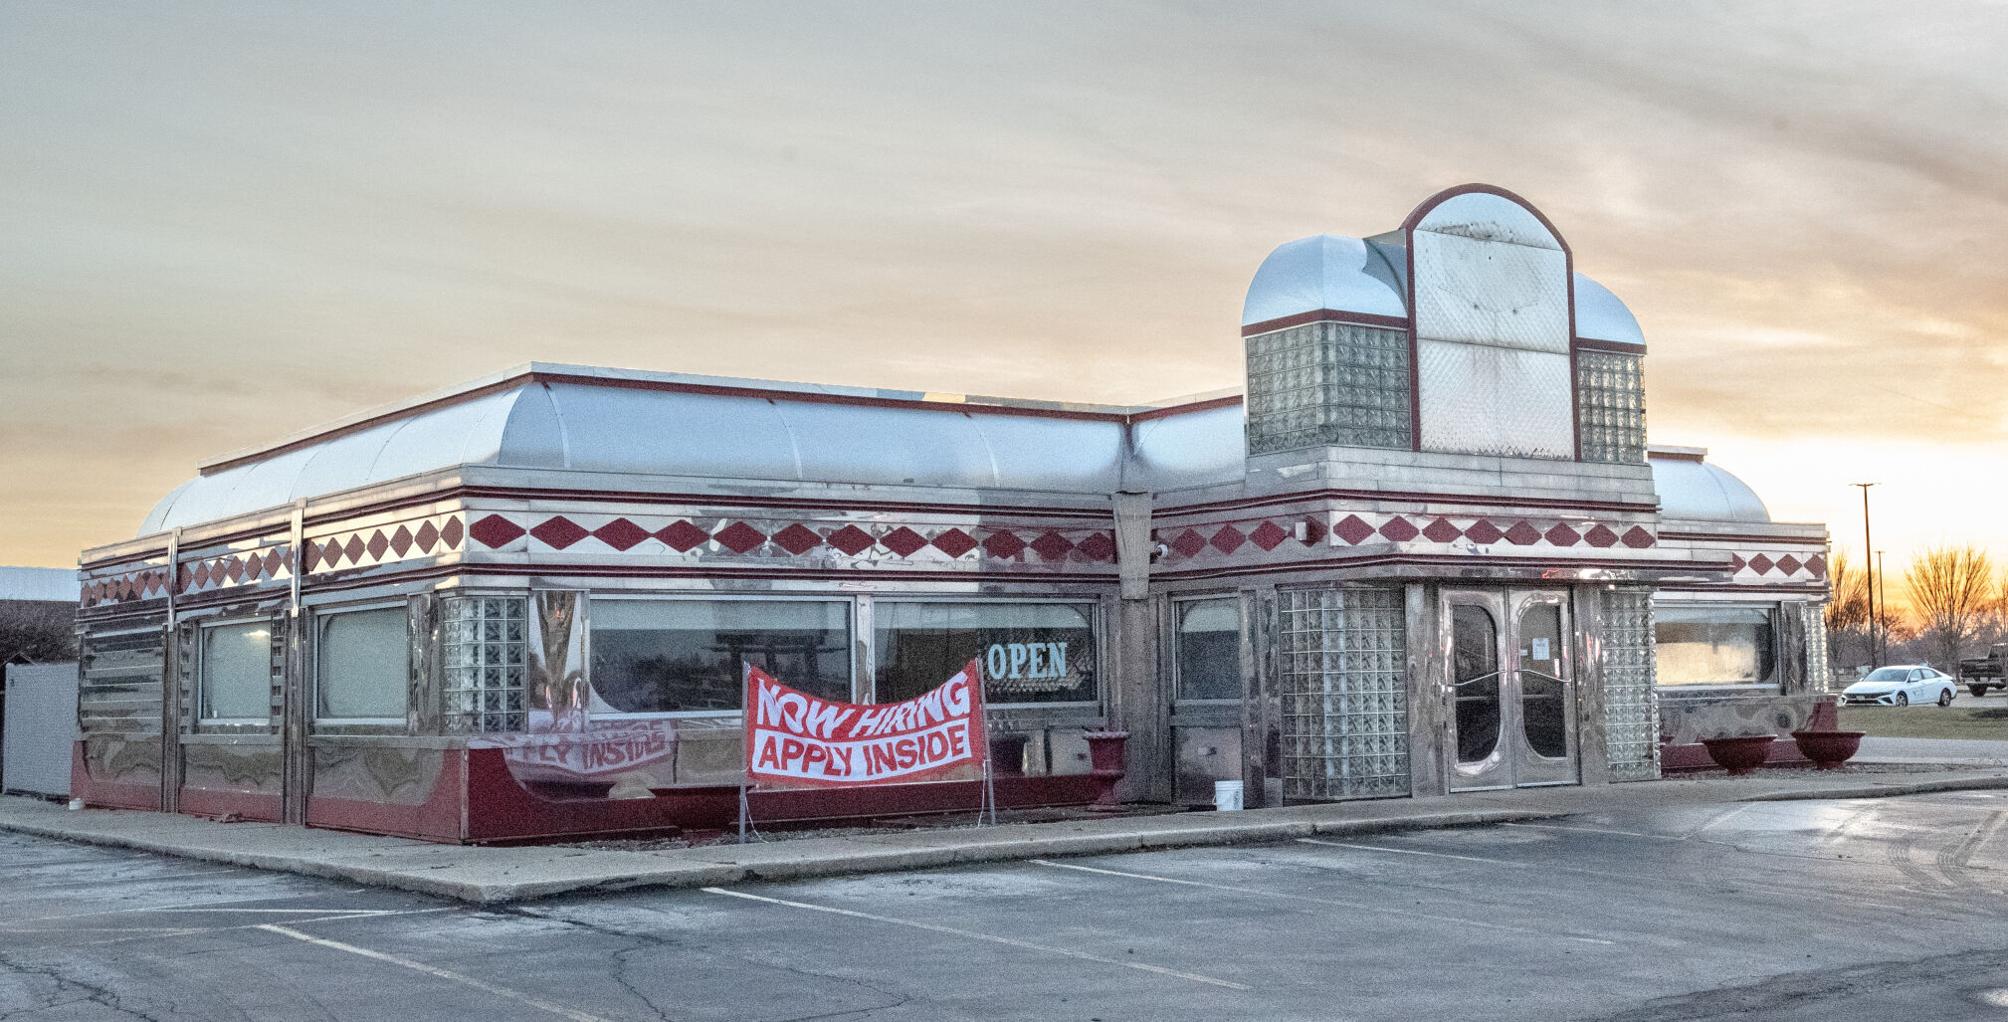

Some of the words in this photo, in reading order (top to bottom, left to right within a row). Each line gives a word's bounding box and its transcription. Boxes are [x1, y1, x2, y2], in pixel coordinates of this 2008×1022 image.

[987, 641, 1067, 680] OPEN
[757, 677, 852, 739] NOW
[849, 671, 971, 738] HIRING
[757, 735, 852, 777] APPLY
[863, 724, 966, 776] INSIDE
